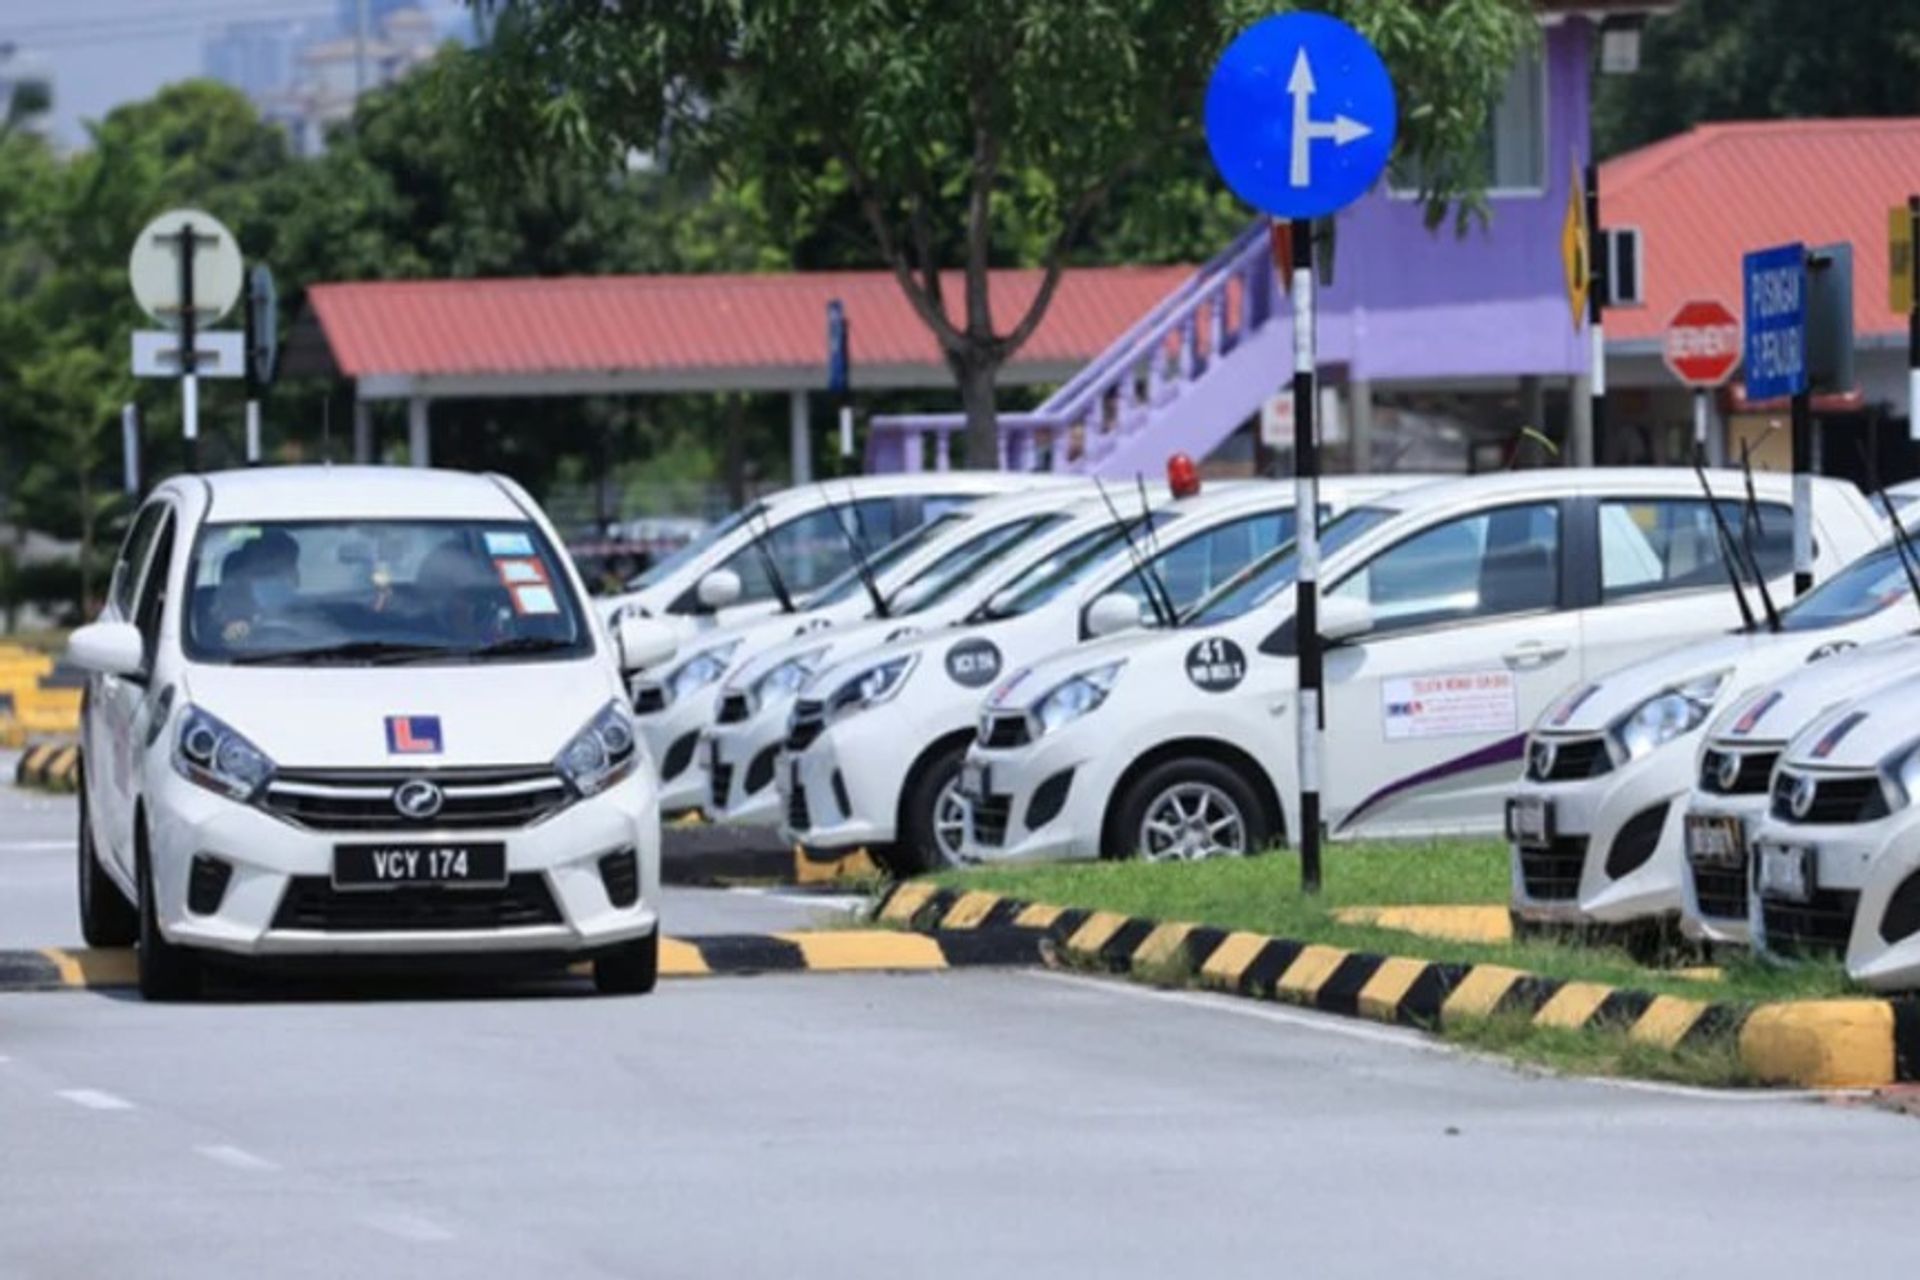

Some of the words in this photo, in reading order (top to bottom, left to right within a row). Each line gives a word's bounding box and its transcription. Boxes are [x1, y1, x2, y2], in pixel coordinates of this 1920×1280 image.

[1197, 639, 1225, 662] 41
[393, 716, 434, 751] L
[373, 851, 420, 878] VCY
[429, 850, 468, 877] 174
